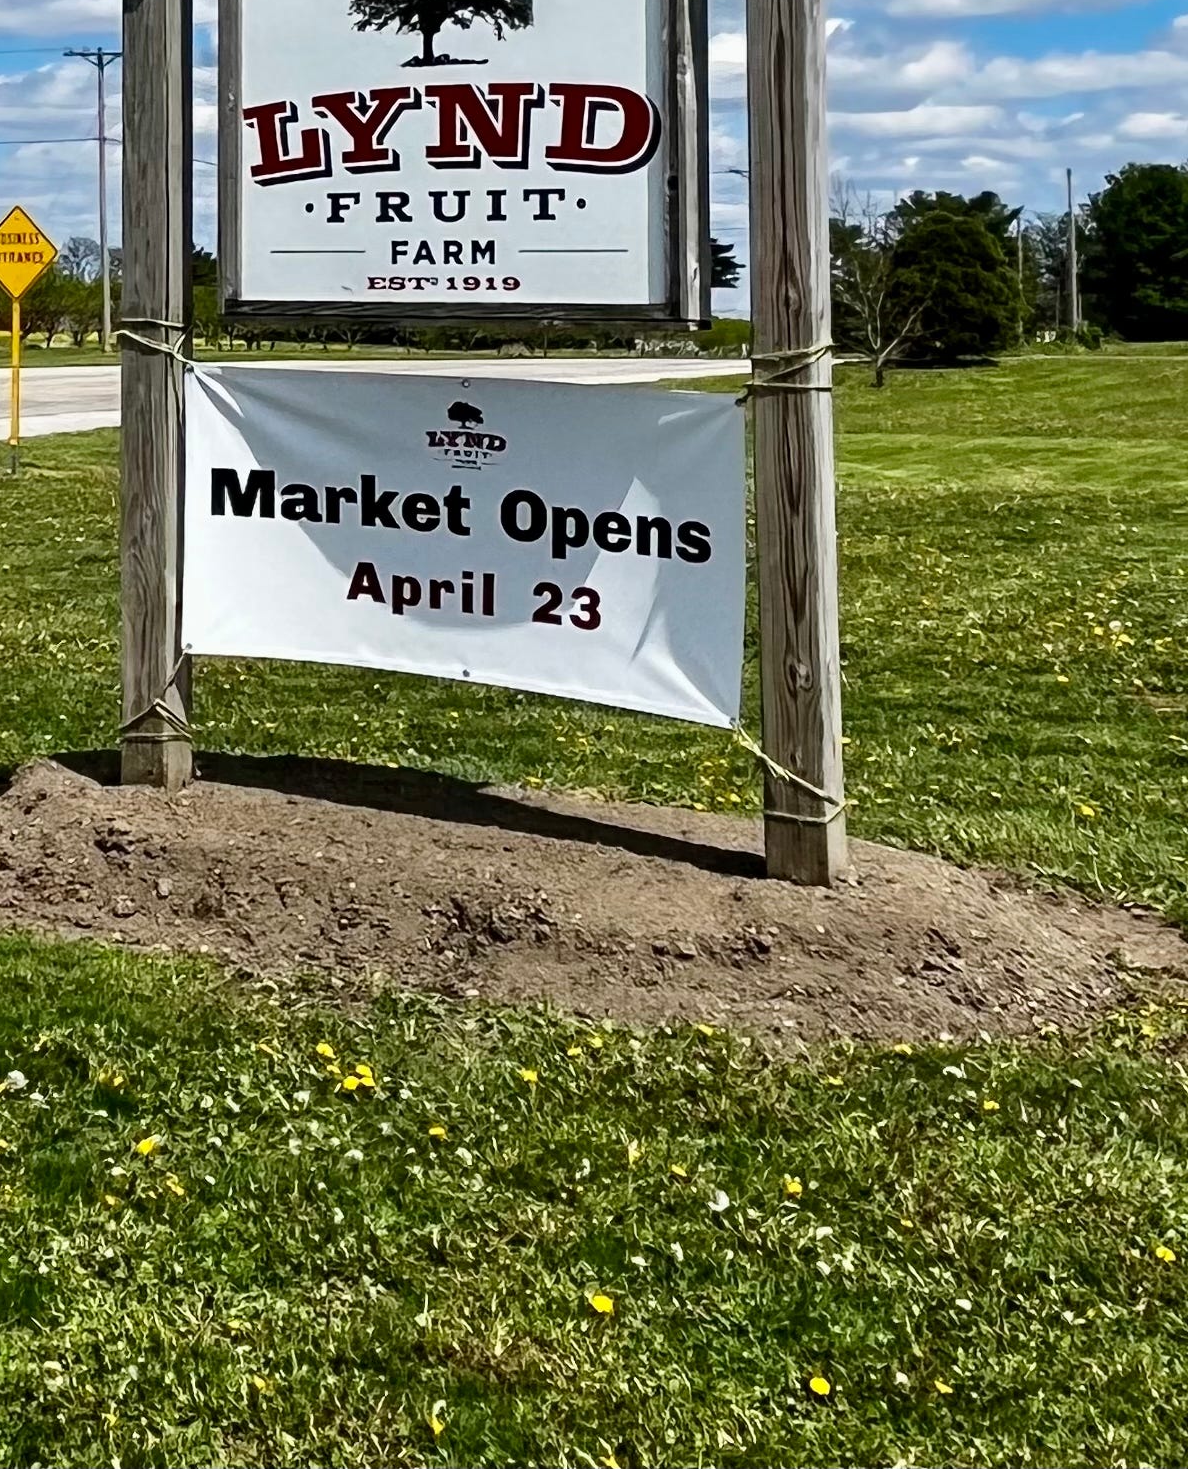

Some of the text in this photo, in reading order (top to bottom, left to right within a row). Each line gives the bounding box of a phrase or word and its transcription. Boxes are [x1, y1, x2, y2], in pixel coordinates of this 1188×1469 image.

[242, 82, 661, 187] LYND
[326, 188, 566, 223] FRUIT
[391, 240, 495, 265] FARM
[446, 276, 521, 291] 1919
[425, 431, 507, 452] LYND
[210, 467, 713, 564] Market Opens
[346, 561, 602, 631] April 23
